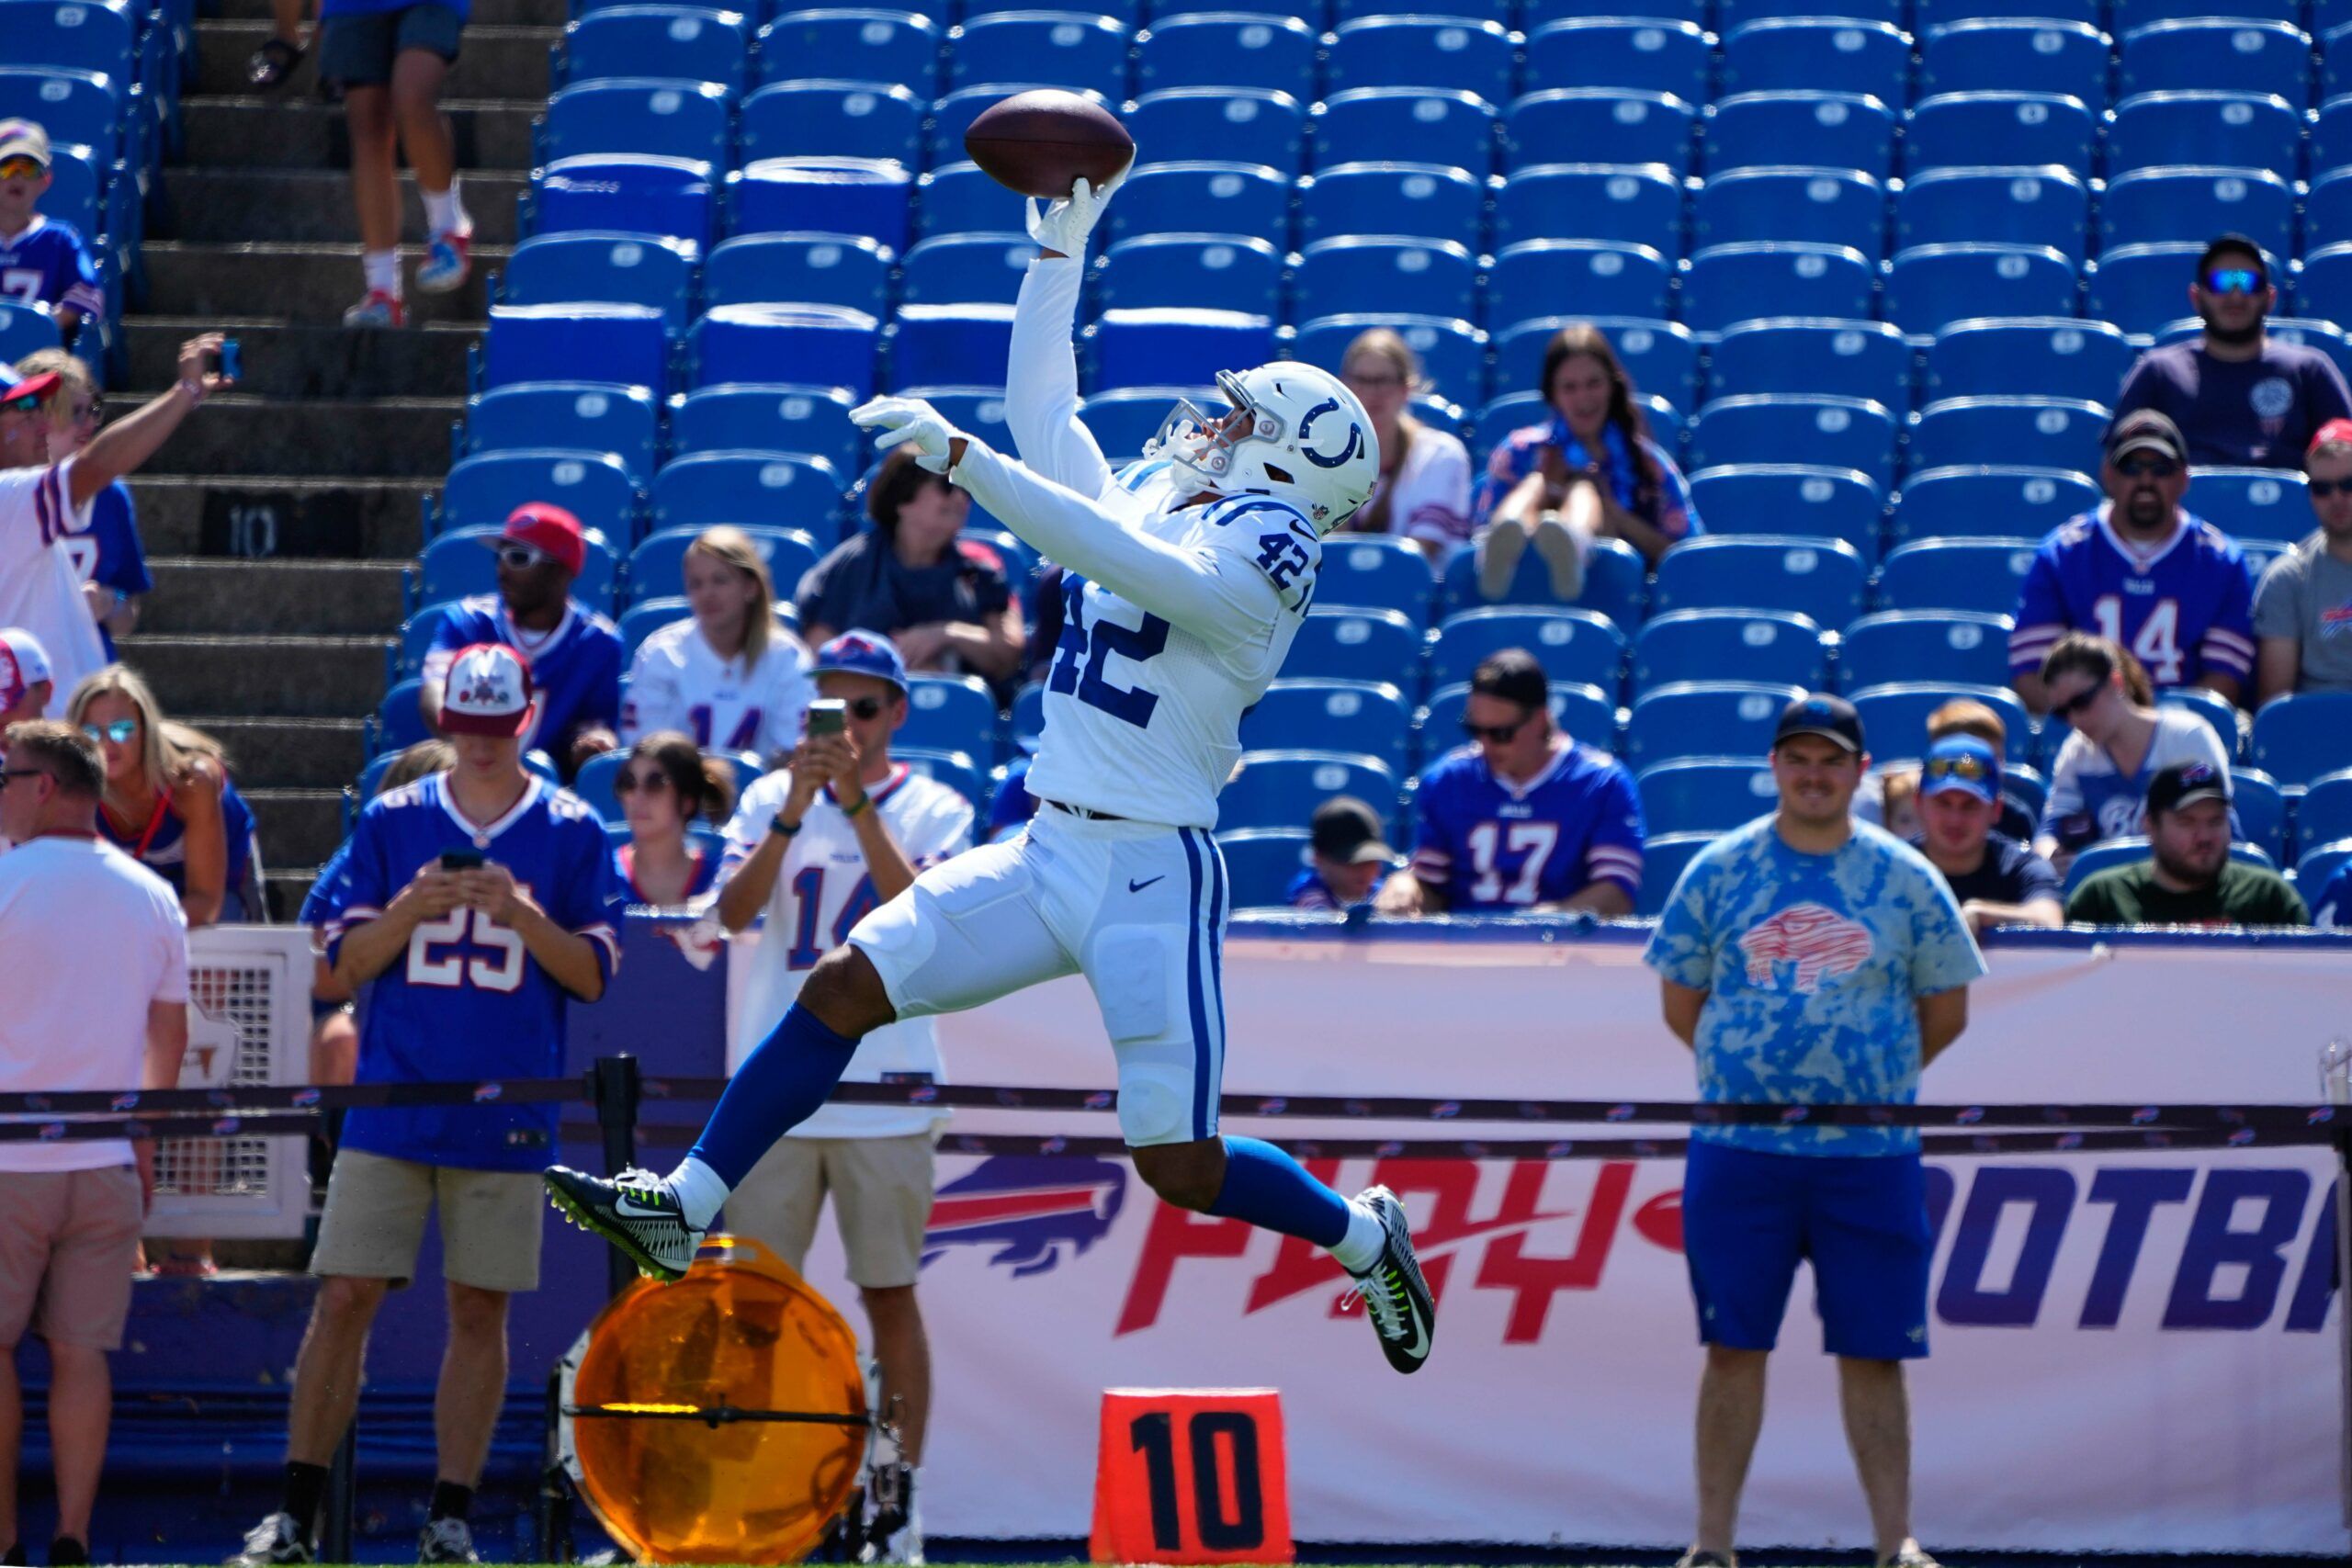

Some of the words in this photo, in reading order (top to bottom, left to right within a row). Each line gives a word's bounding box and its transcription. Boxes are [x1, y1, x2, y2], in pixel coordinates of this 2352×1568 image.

[230, 505, 276, 558] 10
[1257, 533, 1309, 591] 42
[1049, 571, 1170, 729] 42
[2093, 594, 2184, 683] 14
[688, 704, 763, 750] 14
[1468, 823, 1559, 904] 17
[407, 883, 533, 992] 25
[1130, 1412, 1264, 1551] 10
